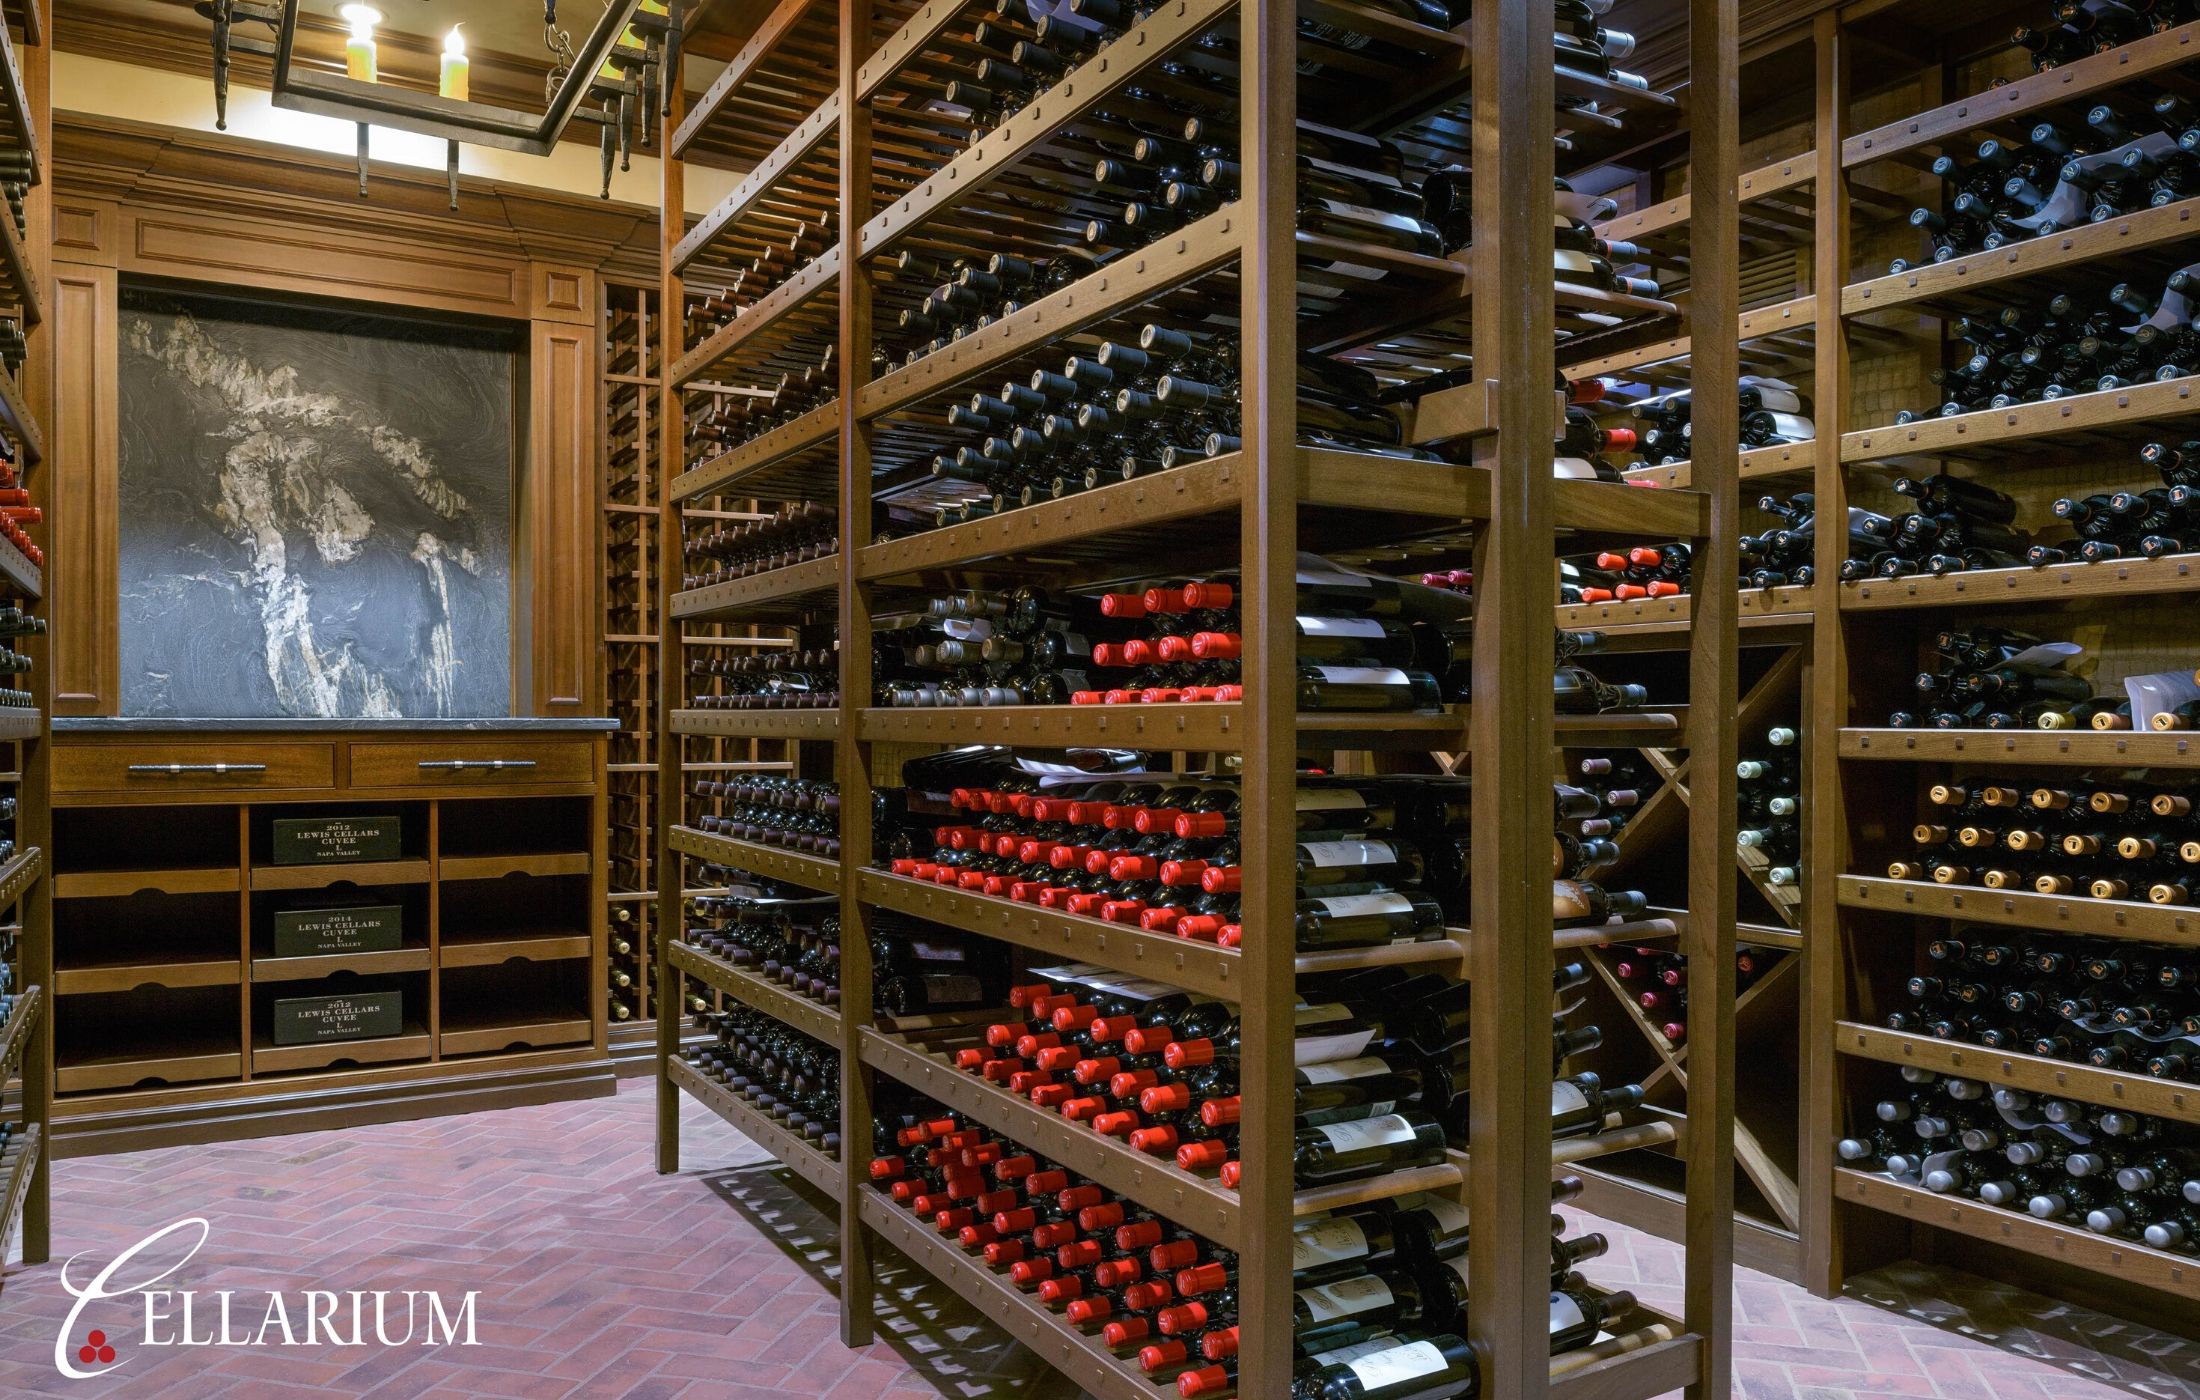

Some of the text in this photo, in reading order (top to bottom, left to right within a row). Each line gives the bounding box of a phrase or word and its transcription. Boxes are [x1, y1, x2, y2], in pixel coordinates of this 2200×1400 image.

[297, 829, 380, 839] LEWIS CELLARS
[321, 837, 357, 845] CUVEE
[298, 920, 381, 931] LEWIS CELLARS
[322, 928, 357, 937] CUVEE
[298, 1005, 380, 1018] LEWIS CELLARS
[322, 1014, 357, 1023] CUVEE
